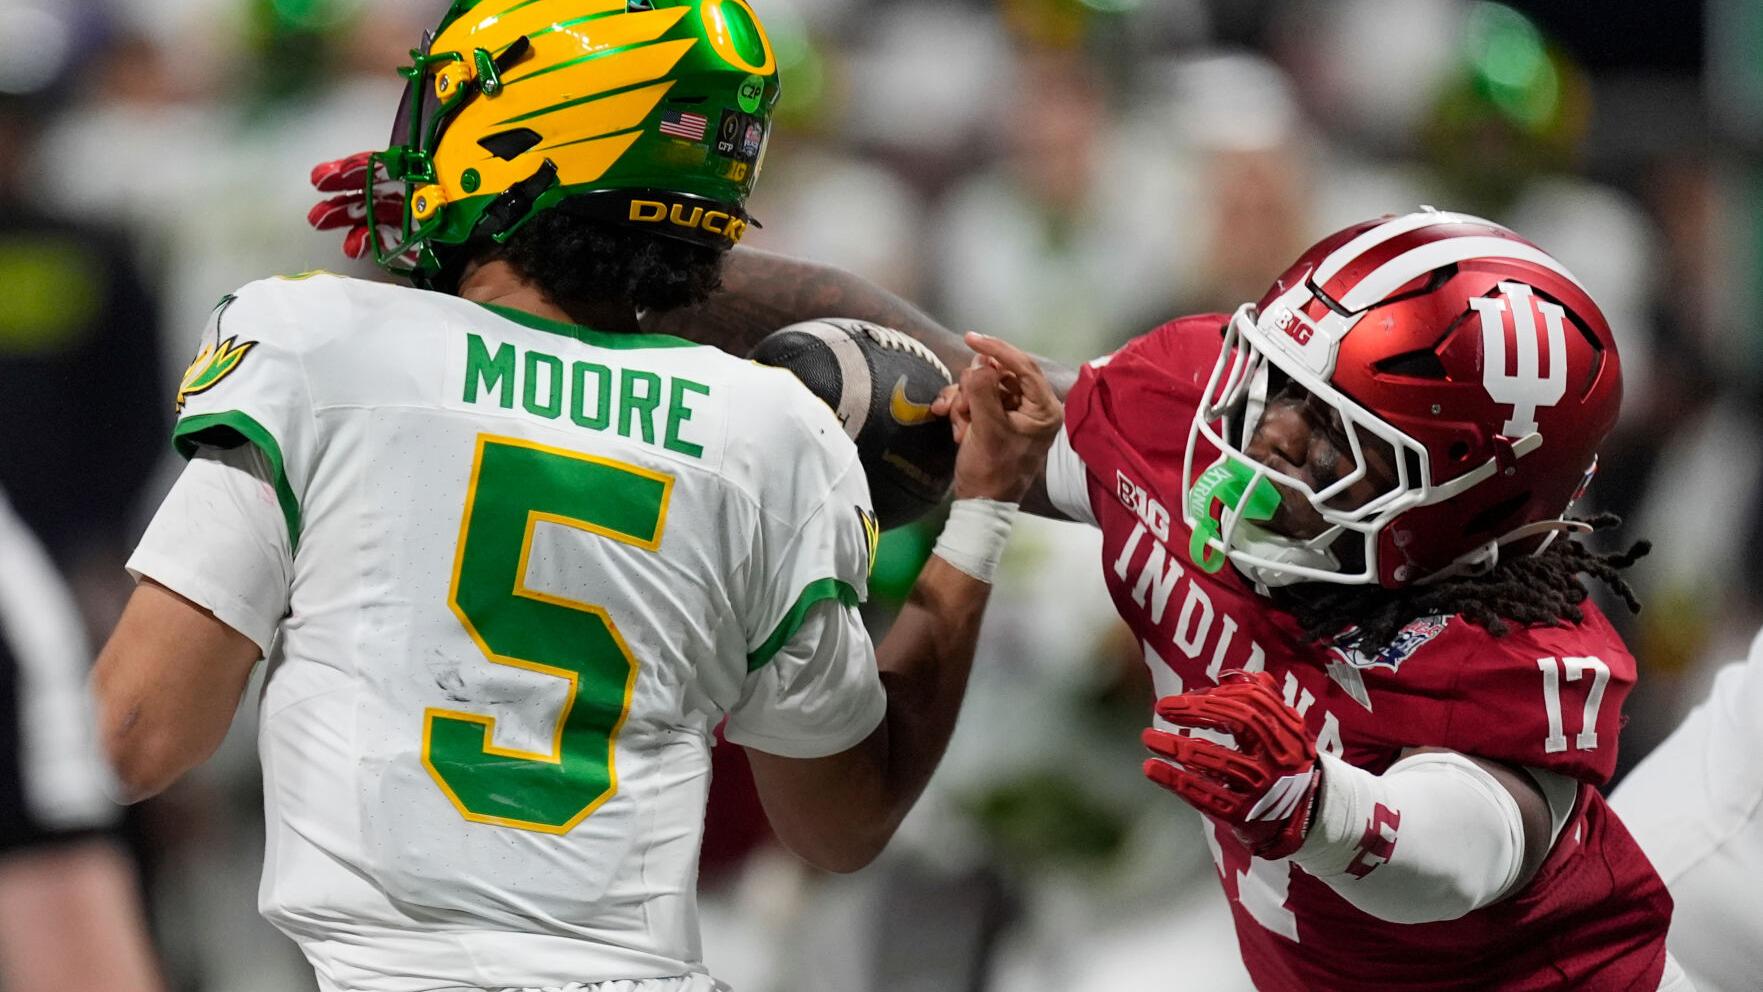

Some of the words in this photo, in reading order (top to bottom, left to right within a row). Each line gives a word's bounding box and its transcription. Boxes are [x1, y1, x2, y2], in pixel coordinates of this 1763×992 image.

[718, 141, 734, 152] CFP
[462, 332, 711, 459] MOORE
[421, 433, 676, 836] 5
[1537, 655, 1611, 753] 17
